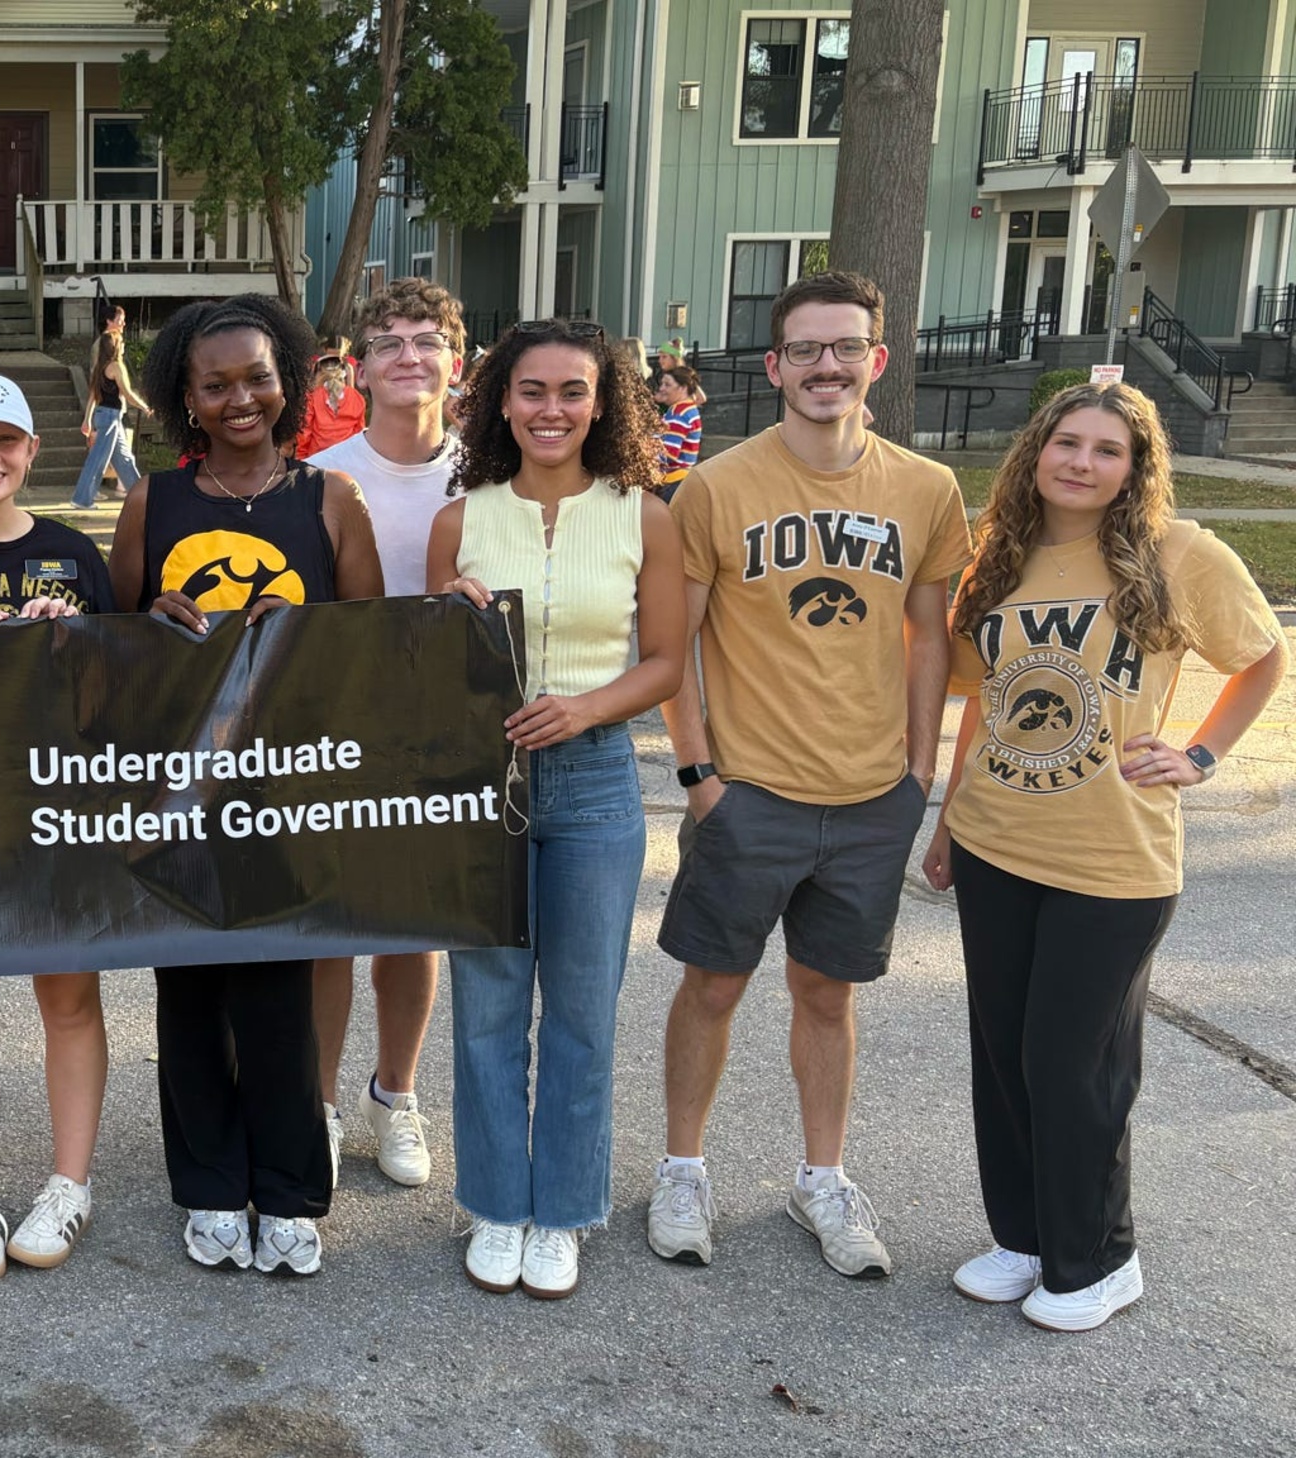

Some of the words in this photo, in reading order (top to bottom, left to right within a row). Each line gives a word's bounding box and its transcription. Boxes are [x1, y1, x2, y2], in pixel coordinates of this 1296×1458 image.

[743, 510, 904, 584] IOWA
[996, 651, 1067, 688] UNIVERSITY
[1067, 661, 1087, 677] OF
[1082, 679, 1100, 716] IOWA
[28, 735, 363, 791] Undergraduate
[1073, 725, 1097, 756] 1847
[30, 801, 207, 846] Student
[220, 785, 499, 840] Government
